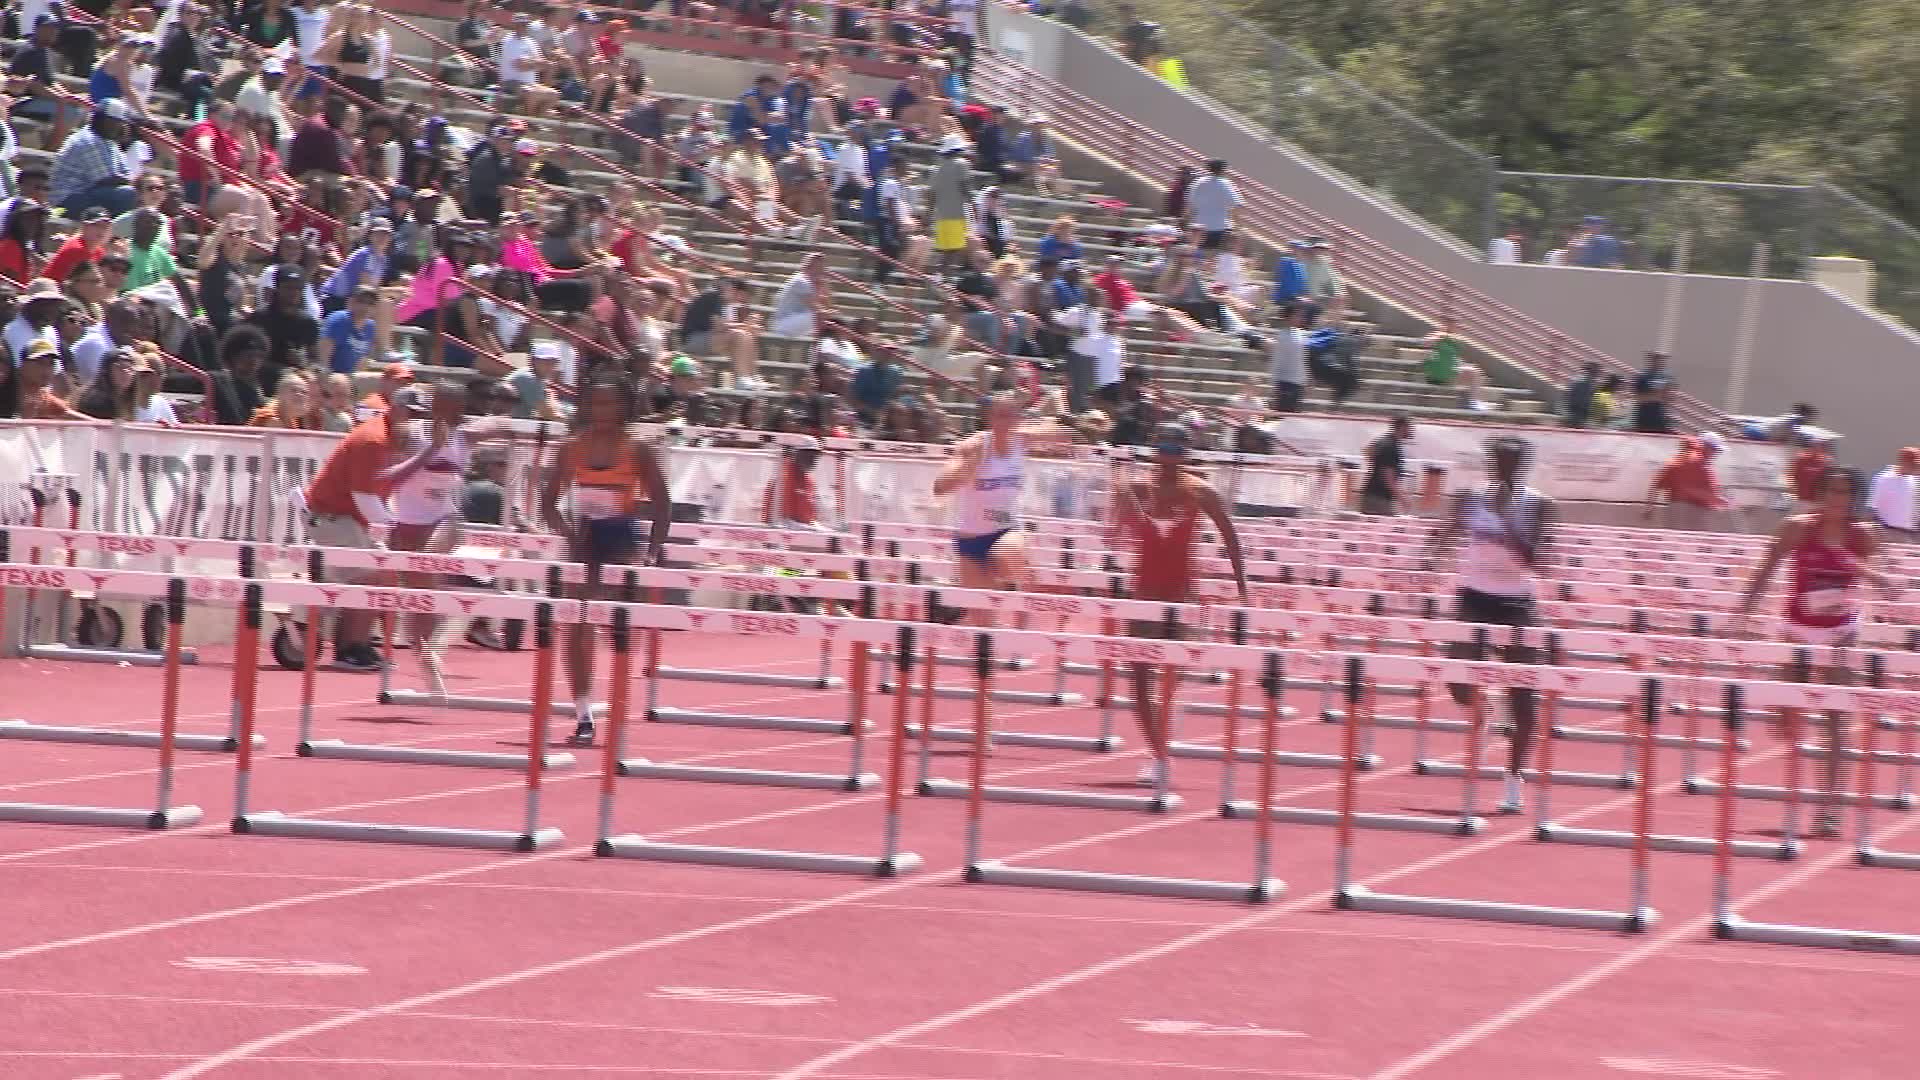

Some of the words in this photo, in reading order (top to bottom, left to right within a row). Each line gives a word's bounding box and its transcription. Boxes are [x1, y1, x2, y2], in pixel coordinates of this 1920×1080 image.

[95, 535, 156, 554] TEXAS
[470, 533, 522, 549] TEXAS
[406, 556, 465, 574] TEXAS
[736, 552, 788, 567] TEXAS
[0, 568, 65, 588] TEXAS
[720, 576, 781, 594] TEXAS
[365, 590, 436, 612] TEXAS
[1022, 597, 1082, 615] TEXAS
[727, 614, 800, 636] TEXAS
[1093, 640, 1167, 661] TEXAS
[1468, 665, 1540, 687] TEXAS
